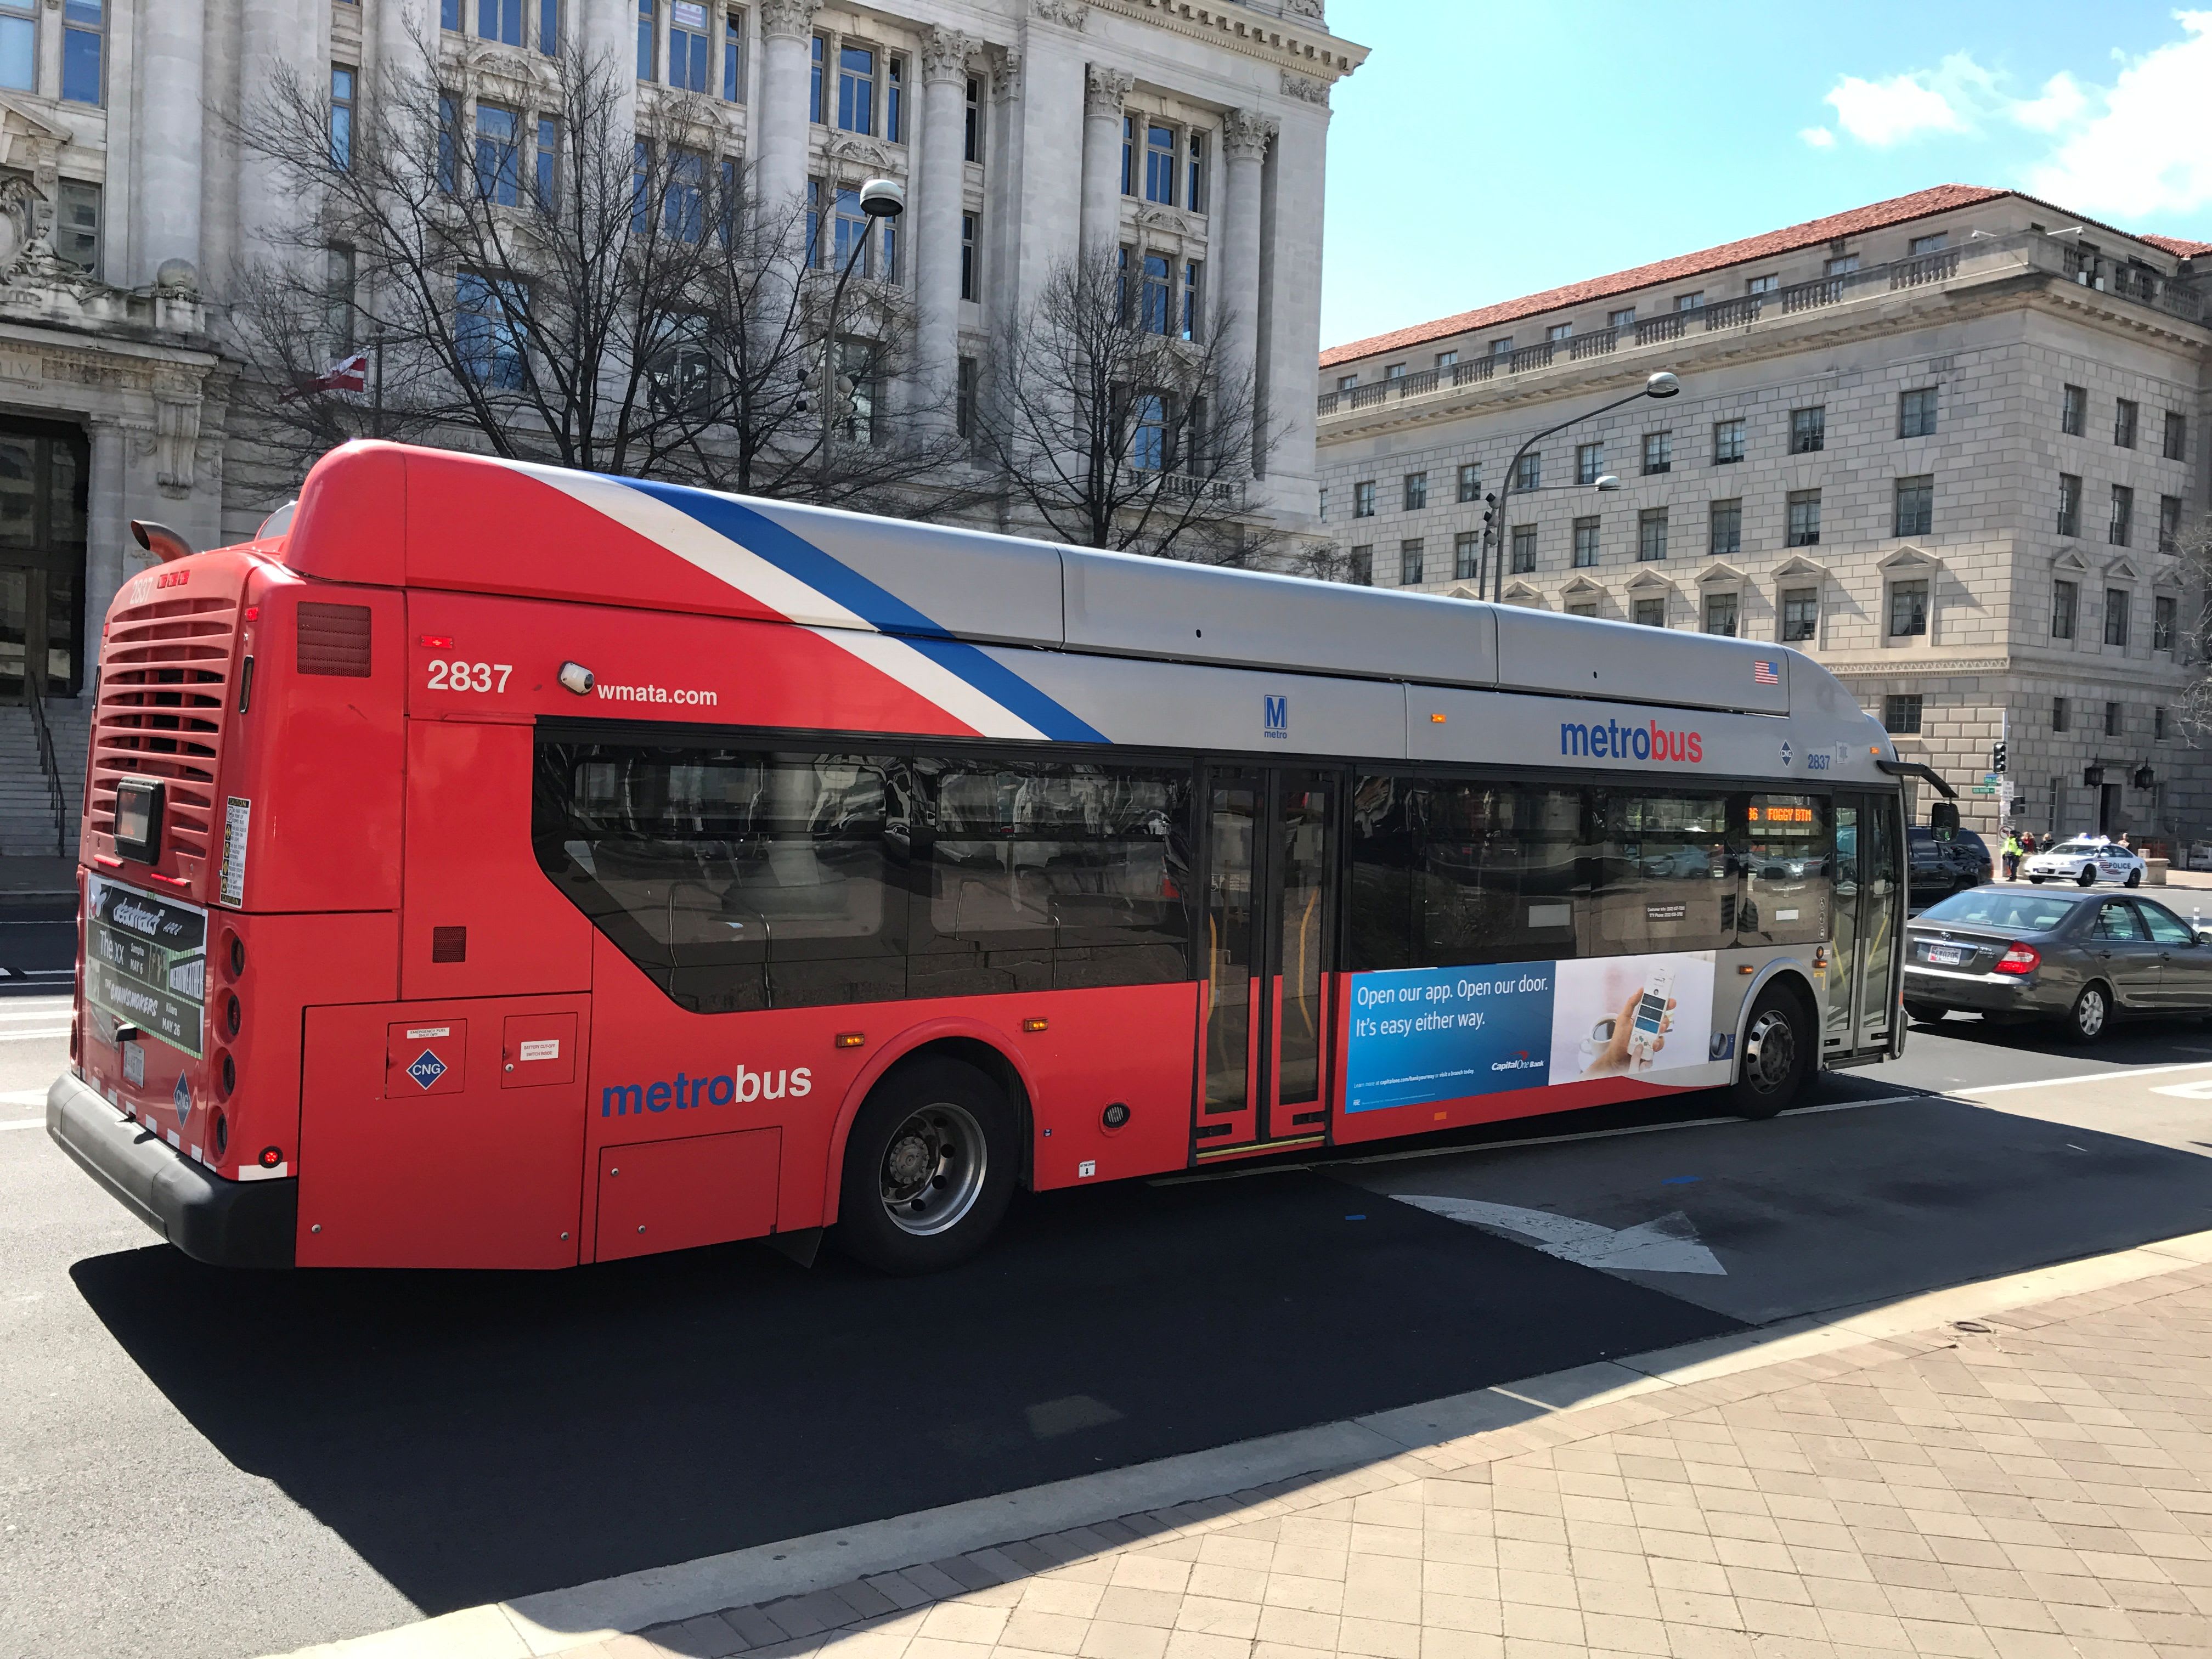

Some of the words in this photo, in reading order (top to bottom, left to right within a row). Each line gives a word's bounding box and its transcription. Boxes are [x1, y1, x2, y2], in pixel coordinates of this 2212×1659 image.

[130, 577, 153, 604] 2837
[427, 659, 512, 693] 2837
[597, 685, 718, 706] wmata.com
[1266, 697, 1285, 727] M
[1264, 731, 1287, 739] metro
[1561, 719, 1702, 763] metrobus
[1808, 754, 1830, 770] 2837
[229, 798, 246, 807] CAUTION
[1768, 808, 1793, 821] FOGGY
[100, 930, 113, 960] The
[130, 959, 139, 972] MAY
[1357, 986, 1394, 1009] Open
[1399, 988, 1422, 1002] our
[1425, 984, 1453, 1004] app.
[1457, 979, 1490, 1001] Open
[1495, 980, 1516, 994] our
[1519, 974, 1548, 992] door.
[162, 1017, 173, 1032] MAY
[174, 1023, 180, 1036] 26
[1356, 1018, 1376, 1037] It's
[1380, 1018, 1412, 1037] easy
[1415, 1011, 1454, 1031] either
[1458, 1012, 1486, 1030] way.
[412, 1064, 441, 1075] CNG
[176, 1090, 189, 1110] CNG
[602, 1064, 811, 1117] metrobus
